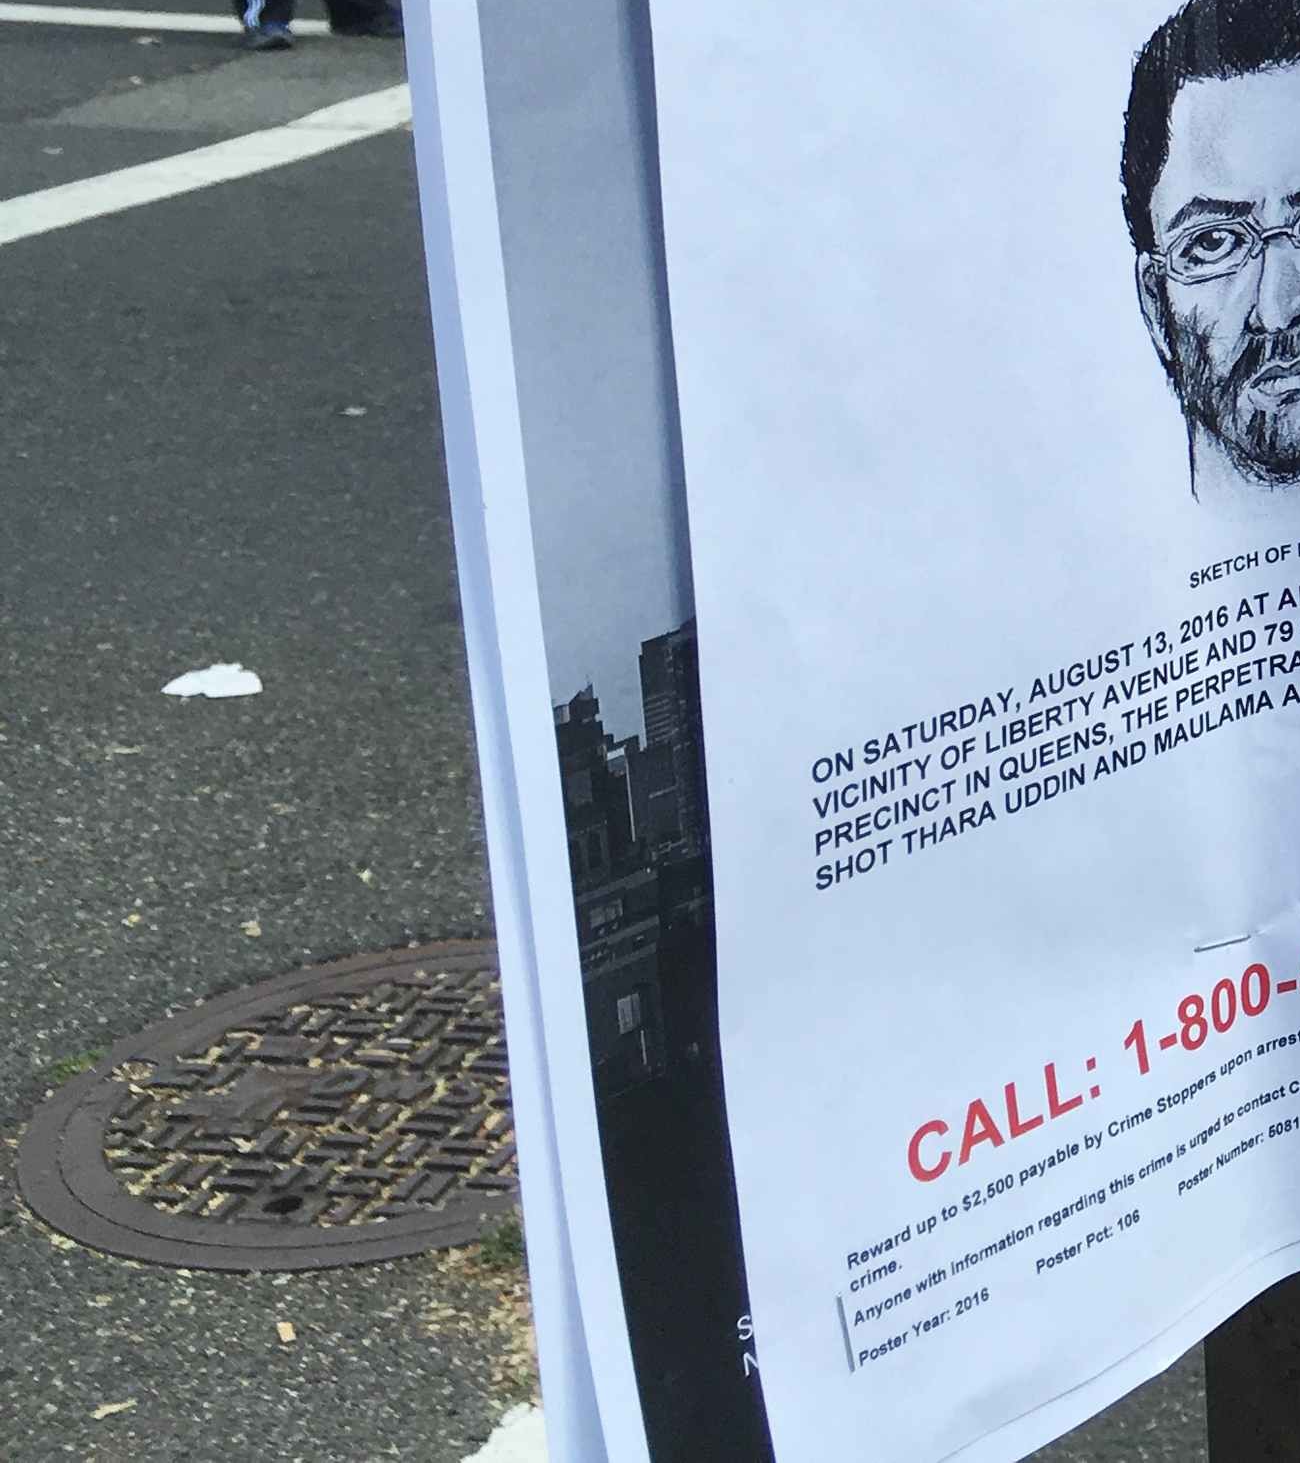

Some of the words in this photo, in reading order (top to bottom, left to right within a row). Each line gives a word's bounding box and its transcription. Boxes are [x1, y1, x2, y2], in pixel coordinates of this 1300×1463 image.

[1189, 551, 1259, 589] SKETCH
[1265, 544, 1292, 564] OF
[811, 748, 854, 783] ON
[863, 687, 1022, 765] SATURDAY,
[1028, 642, 1135, 703] AUGUST
[1142, 631, 1174, 659] 13,
[1179, 605, 1229, 644] 2016
[1236, 591, 1270, 622] AT
[812, 753, 932, 820] VICINITY
[940, 737, 976, 770] OF
[985, 691, 1095, 755] LIBERTY
[1102, 649, 1200, 709] AVENUE
[1205, 629, 1257, 667] AND
[1264, 620, 1294, 646] 79
[814, 779, 957, 857] PRECINCT
[965, 765, 991, 796] IN
[999, 721, 1115, 782] QUEENS,
[1121, 696, 1169, 734] THE
[815, 838, 895, 891] SHOT
[900, 799, 997, 855] THARA
[1004, 762, 1086, 815] UDDIN
[1093, 740, 1147, 781] AND
[1153, 689, 1274, 756] MAULAMA
[846, 1225, 912, 1271] Reward
[916, 1215, 938, 1236] up
[941, 1203, 959, 1225] to
[961, 1173, 1015, 1214] $2,500
[1018, 1140, 1081, 1187] payable
[1084, 1129, 1104, 1151] by
[1107, 1106, 1154, 1138] Crime
[1156, 1071, 1218, 1114] Stoppers
[1219, 1049, 1253, 1078] upon
[907, 1056, 1101, 1183] CALL:
[1176, 1163, 1215, 1197] Poster
[1215, 1130, 1265, 1170] Number:
[849, 1258, 903, 1294] crime.
[853, 1287, 912, 1327] Anyone
[916, 1268, 947, 1293] with
[1038, 1187, 1107, 1232] regarding
[1108, 1173, 1135, 1196] this
[1138, 1150, 1174, 1180] crime
[1176, 1143, 1187, 1158] is
[1189, 1120, 1222, 1150] urged
[1223, 1109, 1235, 1128] to
[1237, 1086, 1287, 1118] contact
[1034, 1242, 1083, 1275] Poster
[1086, 1224, 1115, 1250] Pct:
[1116, 1208, 1142, 1232] 106
[857, 1329, 909, 1368] Poster
[911, 1308, 952, 1338] Year:
[953, 1285, 991, 1317] 2016
